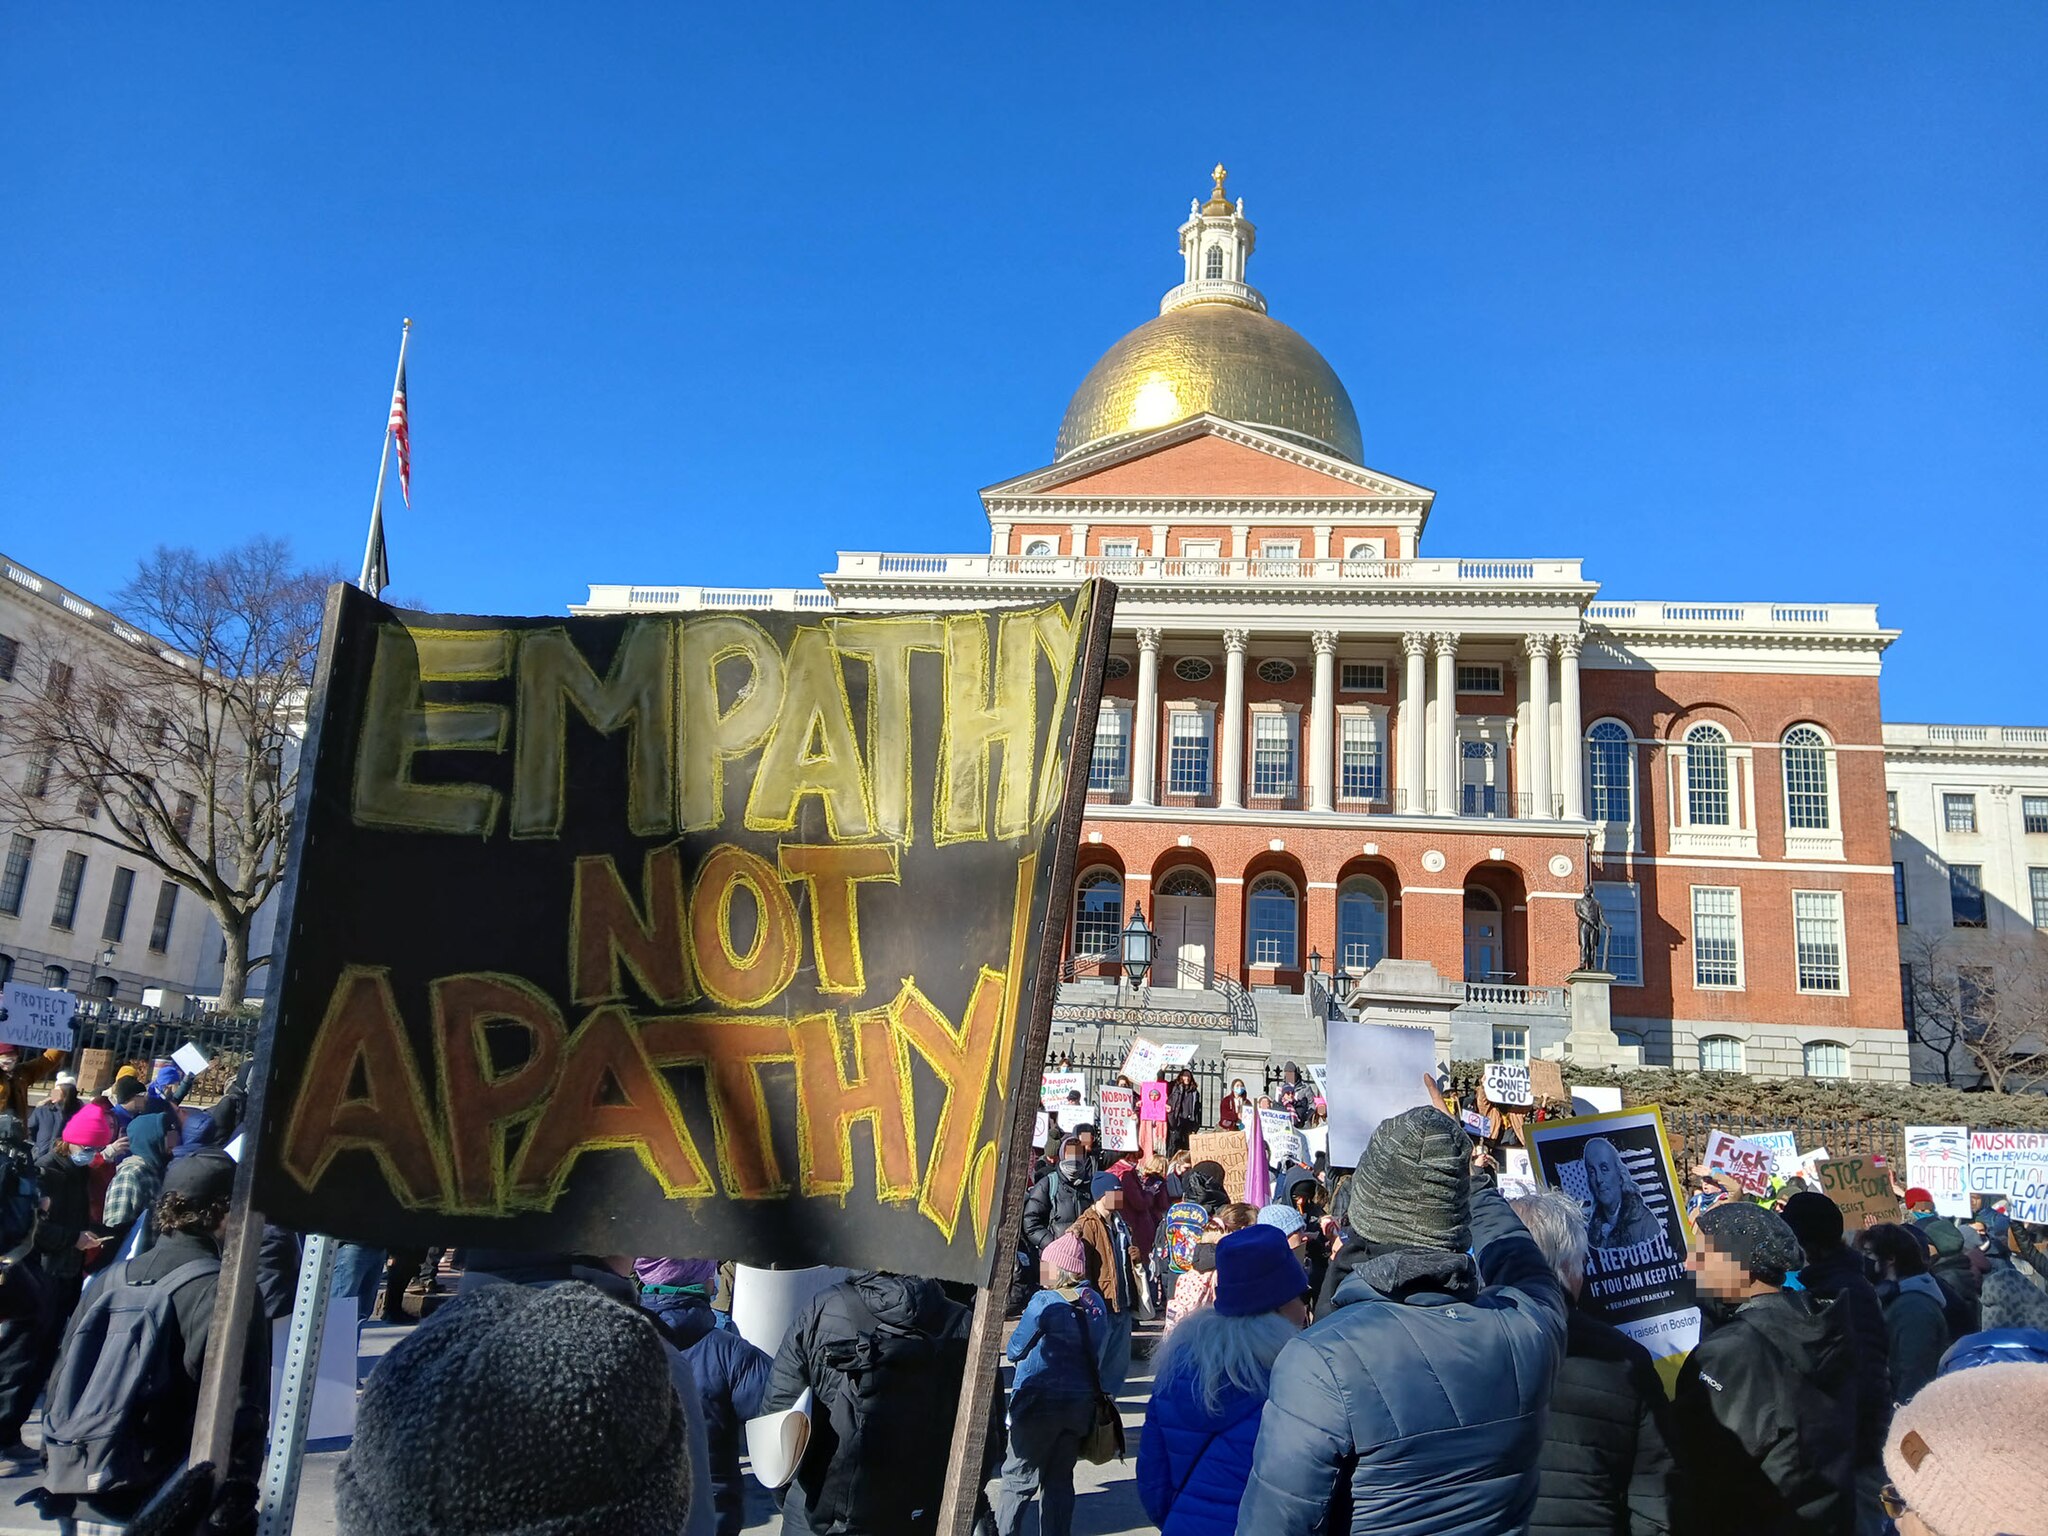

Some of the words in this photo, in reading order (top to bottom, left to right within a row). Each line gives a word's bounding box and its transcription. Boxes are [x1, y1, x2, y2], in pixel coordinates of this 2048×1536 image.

[352, 600, 1080, 846] EMPATHY
[570, 838, 901, 1010] NOT
[14, 991, 68, 1015] PROTECT
[29, 1013, 55, 1026] THE
[1188, 1013, 1232, 1026] HOUSE
[6, 1025, 71, 1050] VULNERABLE
[282, 852, 1037, 1255] APATHY!
[1487, 1077, 1531, 1093] CONNED
[1101, 1091, 1133, 1104] NOBODY
[1497, 1090, 1526, 1103] YOU
[1102, 1106, 1134, 1118] VOTED
[1109, 1118, 1124, 1127] FOR
[1105, 1128, 1128, 1136] ELON
[1192, 1137, 1215, 1152] THE
[1219, 1135, 1245, 1150] ONLY
[1820, 1160, 1863, 1190] STOP
[1971, 1166, 2001, 1191] GET
[1838, 1201, 1865, 1214] ESIST
[1590, 1282, 1600, 1298] IF
[1601, 1275, 1622, 1295] YOU
[1623, 1268, 1644, 1291] CAN
[1644, 1259, 1668, 1287] KEEP
[1641, 1290, 1671, 1303] FRANKLIN
[1634, 1323, 1660, 1339] raised
[1660, 1321, 1670, 1333] in
[1670, 1315, 1700, 1331] Boston.
